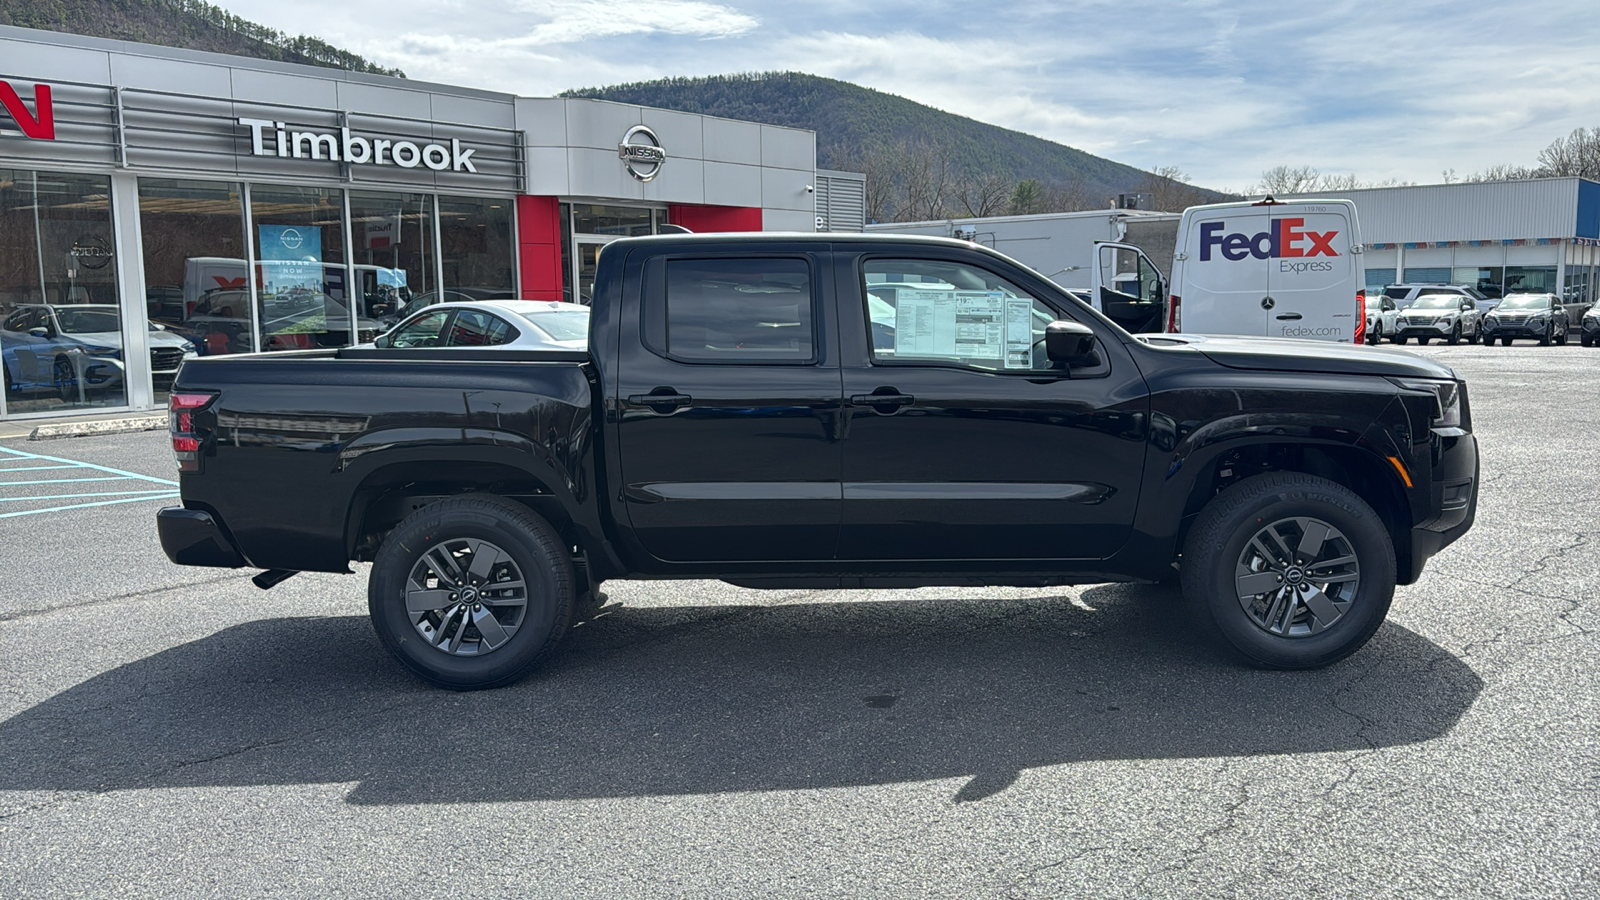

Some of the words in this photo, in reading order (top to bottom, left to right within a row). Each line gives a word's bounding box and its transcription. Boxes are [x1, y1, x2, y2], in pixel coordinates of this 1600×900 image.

[238, 117, 478, 173] Timbrook
[624, 146, 664, 159] NISSAN
[1200, 217, 1340, 262] FedEx
[1280, 260, 1333, 275] Express
[1281, 325, 1341, 337] fedex.com
